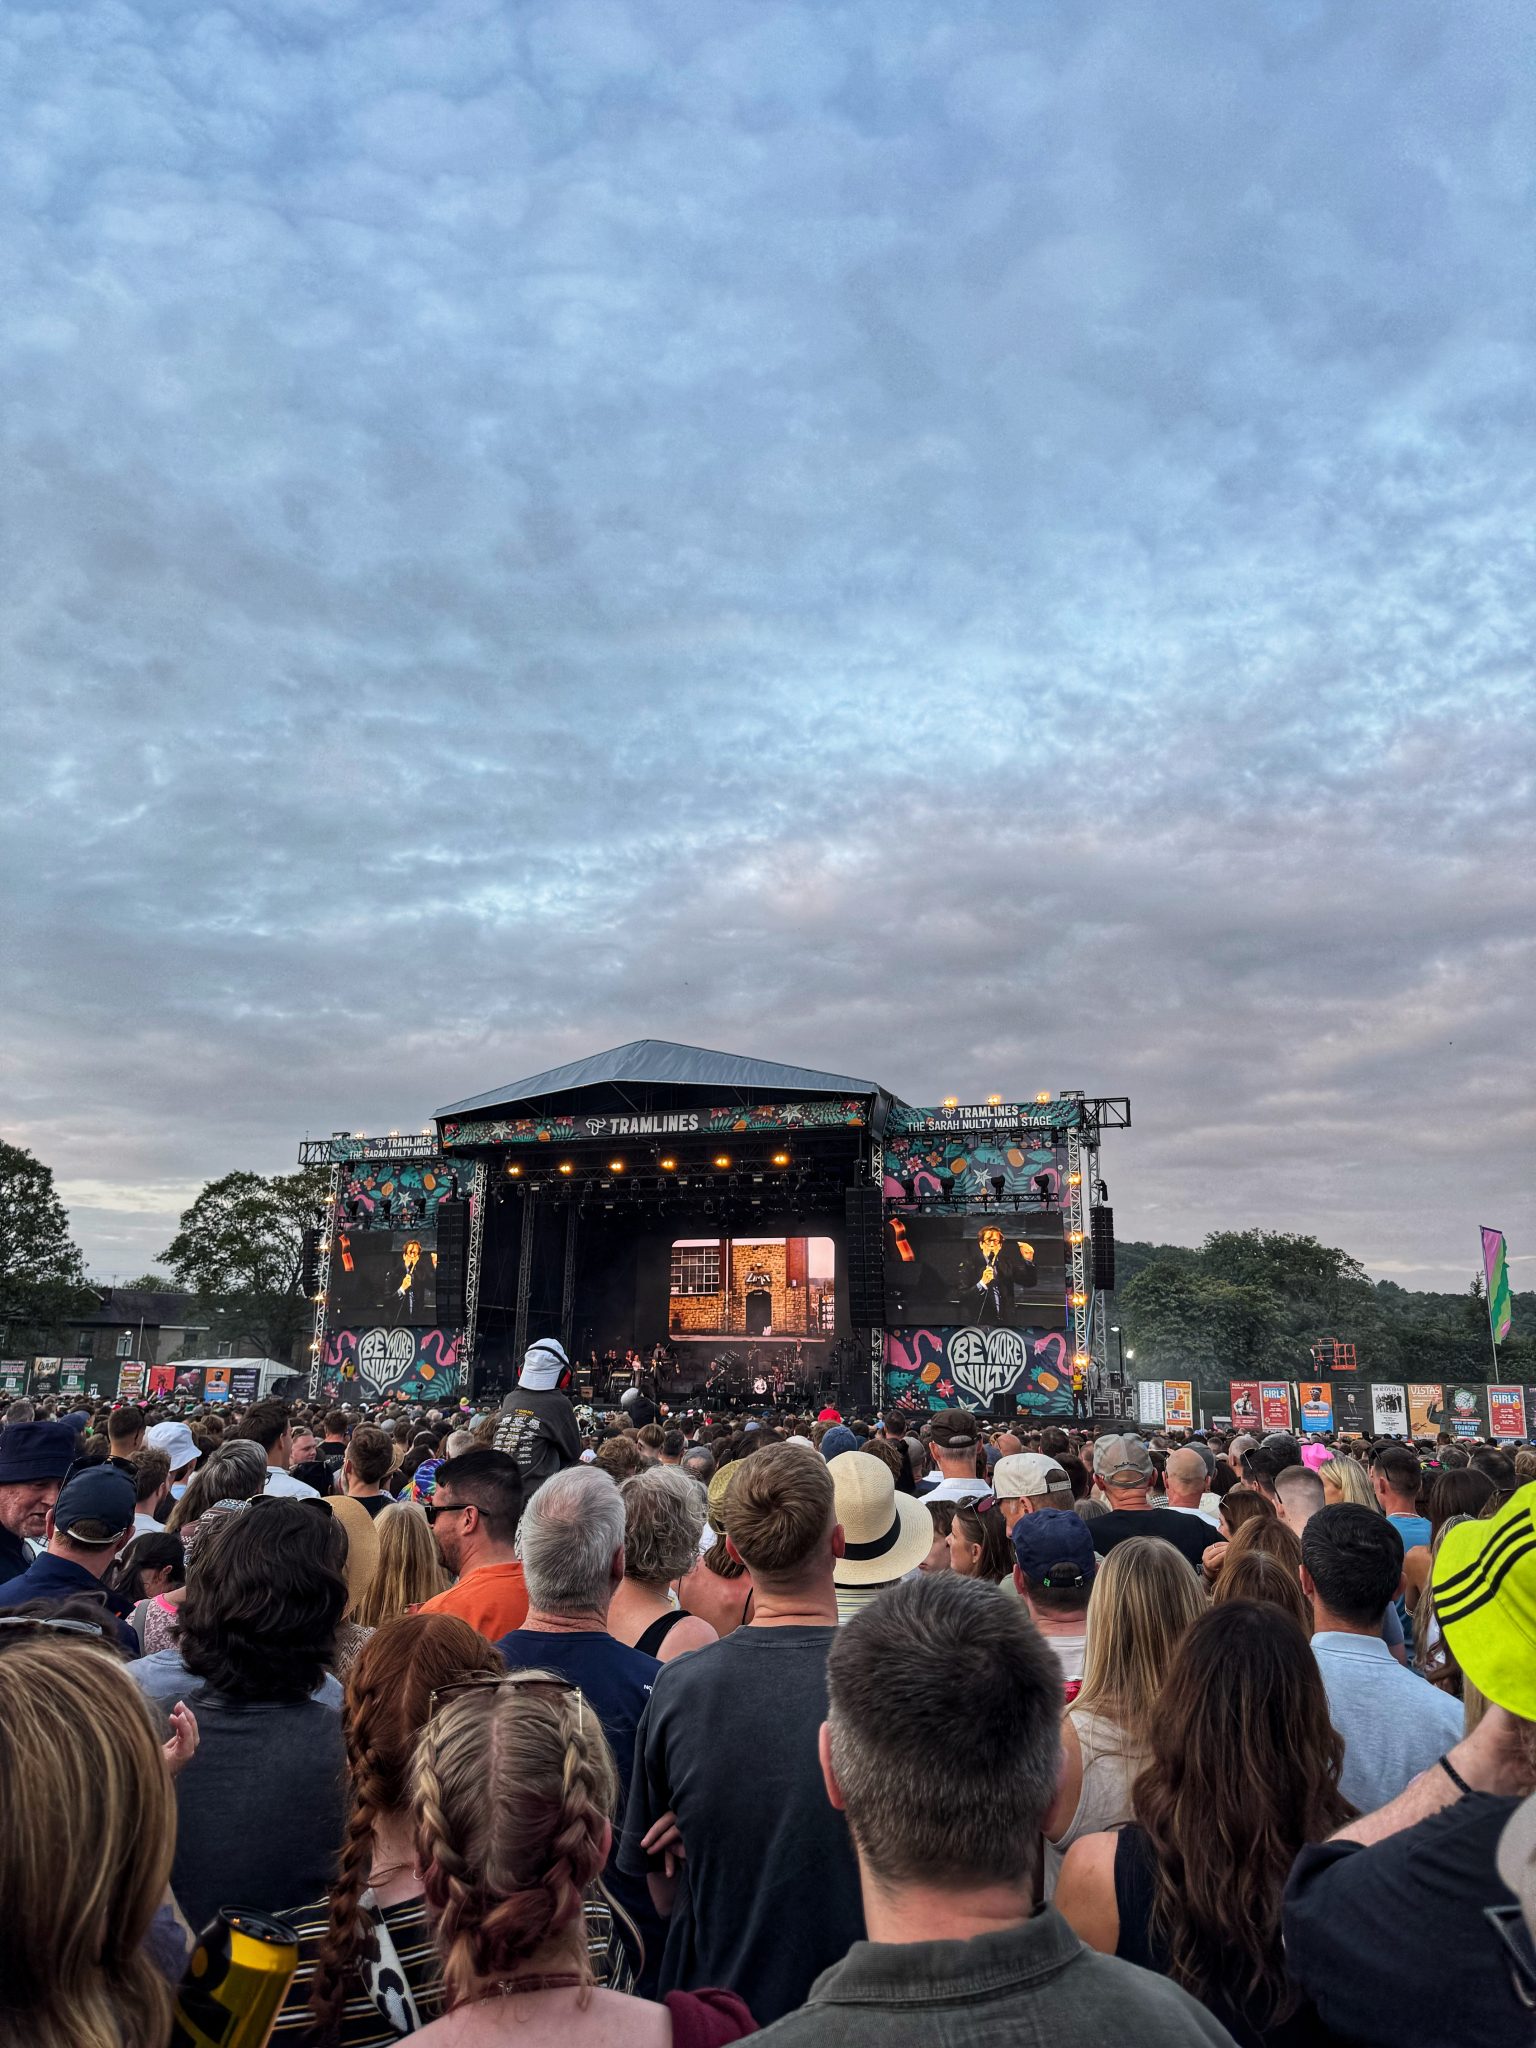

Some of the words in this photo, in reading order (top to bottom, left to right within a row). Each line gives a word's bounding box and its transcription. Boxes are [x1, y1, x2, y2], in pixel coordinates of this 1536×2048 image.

[957, 1106, 1019, 1118] TRAMLINES
[610, 1114, 699, 1135] TRAMLINES
[907, 1121, 926, 1132] THE
[928, 1119, 960, 1131] SARAH
[962, 1118, 992, 1129] NULTY
[994, 1117, 1018, 1128] MAIN
[1021, 1115, 1053, 1127] STAGE
[387, 1137, 433, 1148] TRAMLINES
[349, 1150, 363, 1160] THE
[364, 1149, 388, 1158] SARAH
[389, 1147, 412, 1157] NULTY
[412, 1146, 431, 1156] MAIN
[362, 1331, 385, 1359] BE
[386, 1331, 412, 1359] MORE
[953, 1332, 985, 1364] BE
[986, 1332, 1022, 1365] MORE
[362, 1359, 408, 1386] NULTY
[954, 1365, 1017, 1397] NULTY
[1263, 1389, 1286, 1399] GIRLS
[1410, 1386, 1441, 1396] VISTAS
[1492, 1394, 1520, 1404] GIRLS
